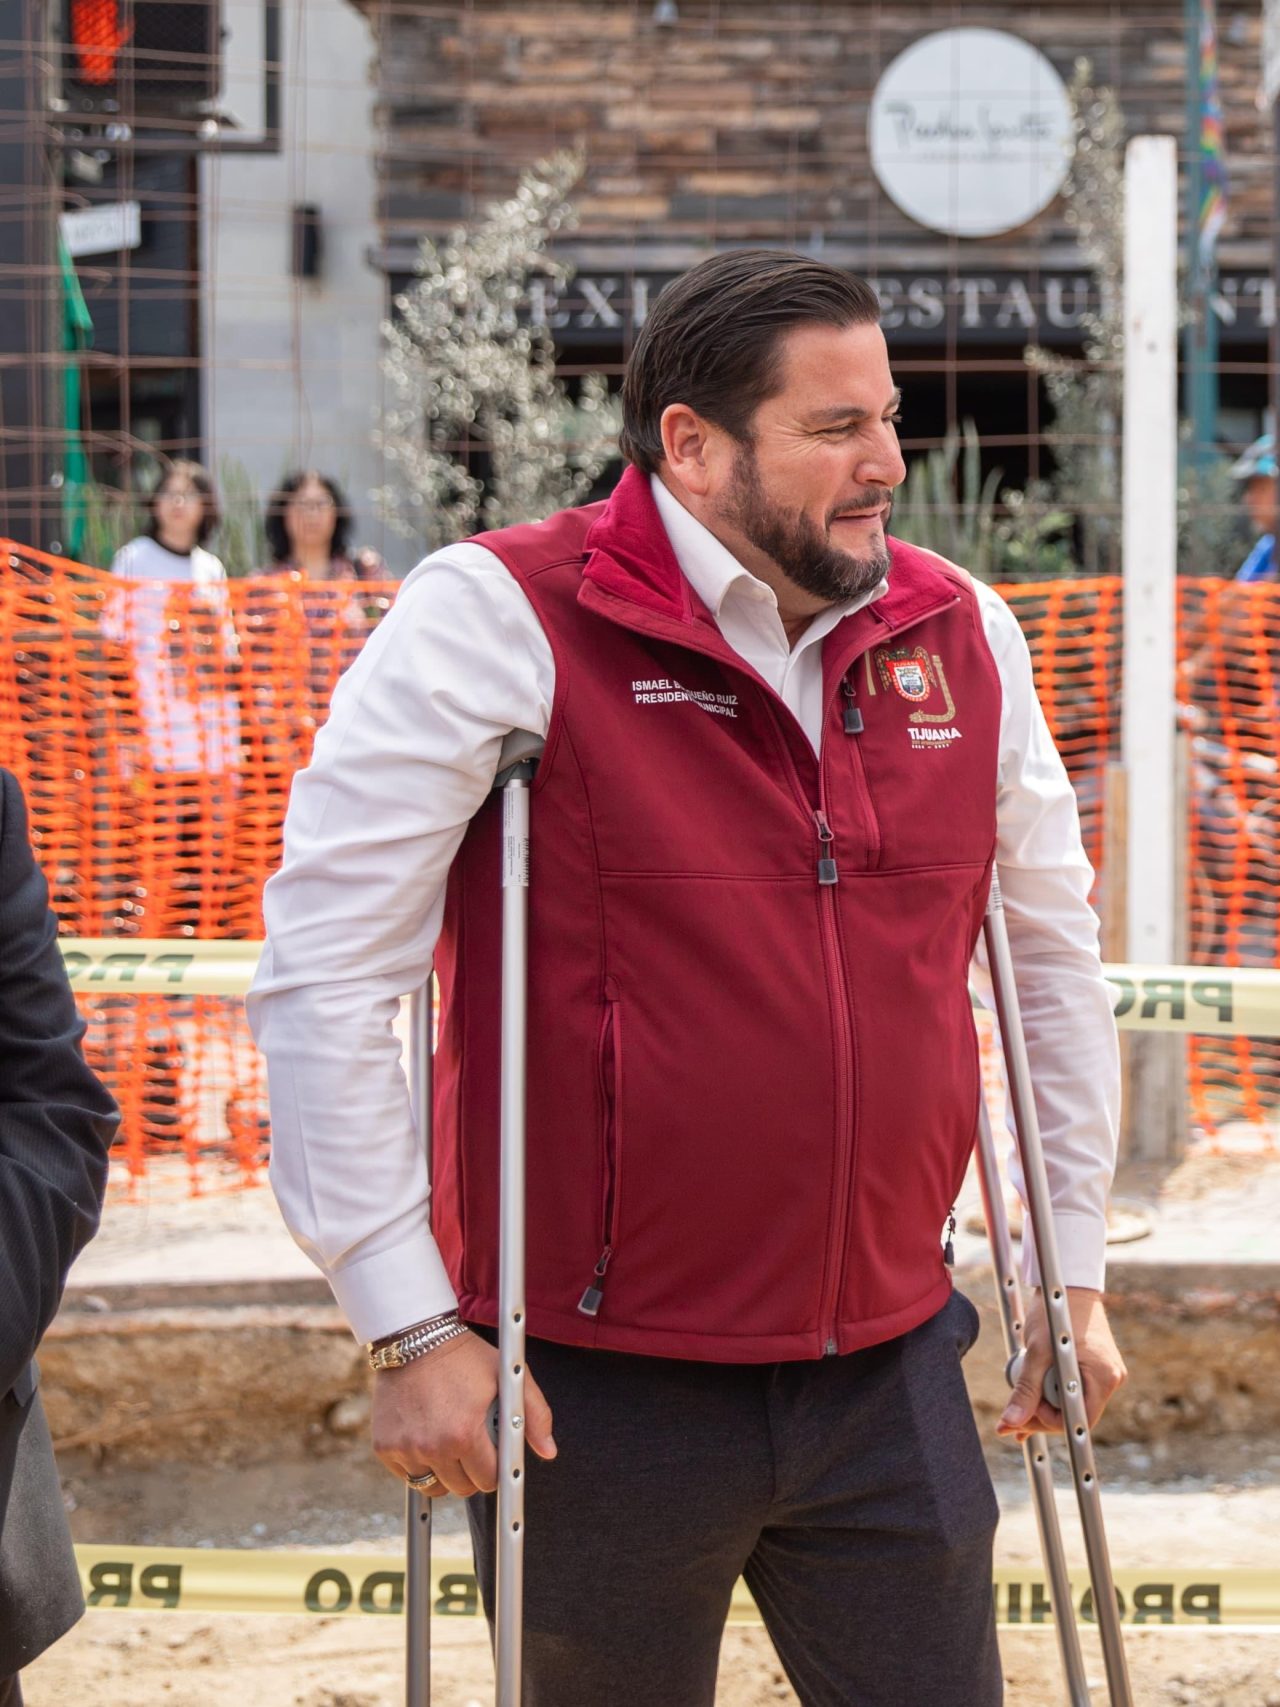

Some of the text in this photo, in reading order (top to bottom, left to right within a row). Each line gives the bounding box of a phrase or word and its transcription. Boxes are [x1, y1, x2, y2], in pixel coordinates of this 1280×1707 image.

[632, 679, 673, 691] ISMAEL
[716, 694, 739, 705] RUIZ
[907, 727, 963, 740] TIJUANA
